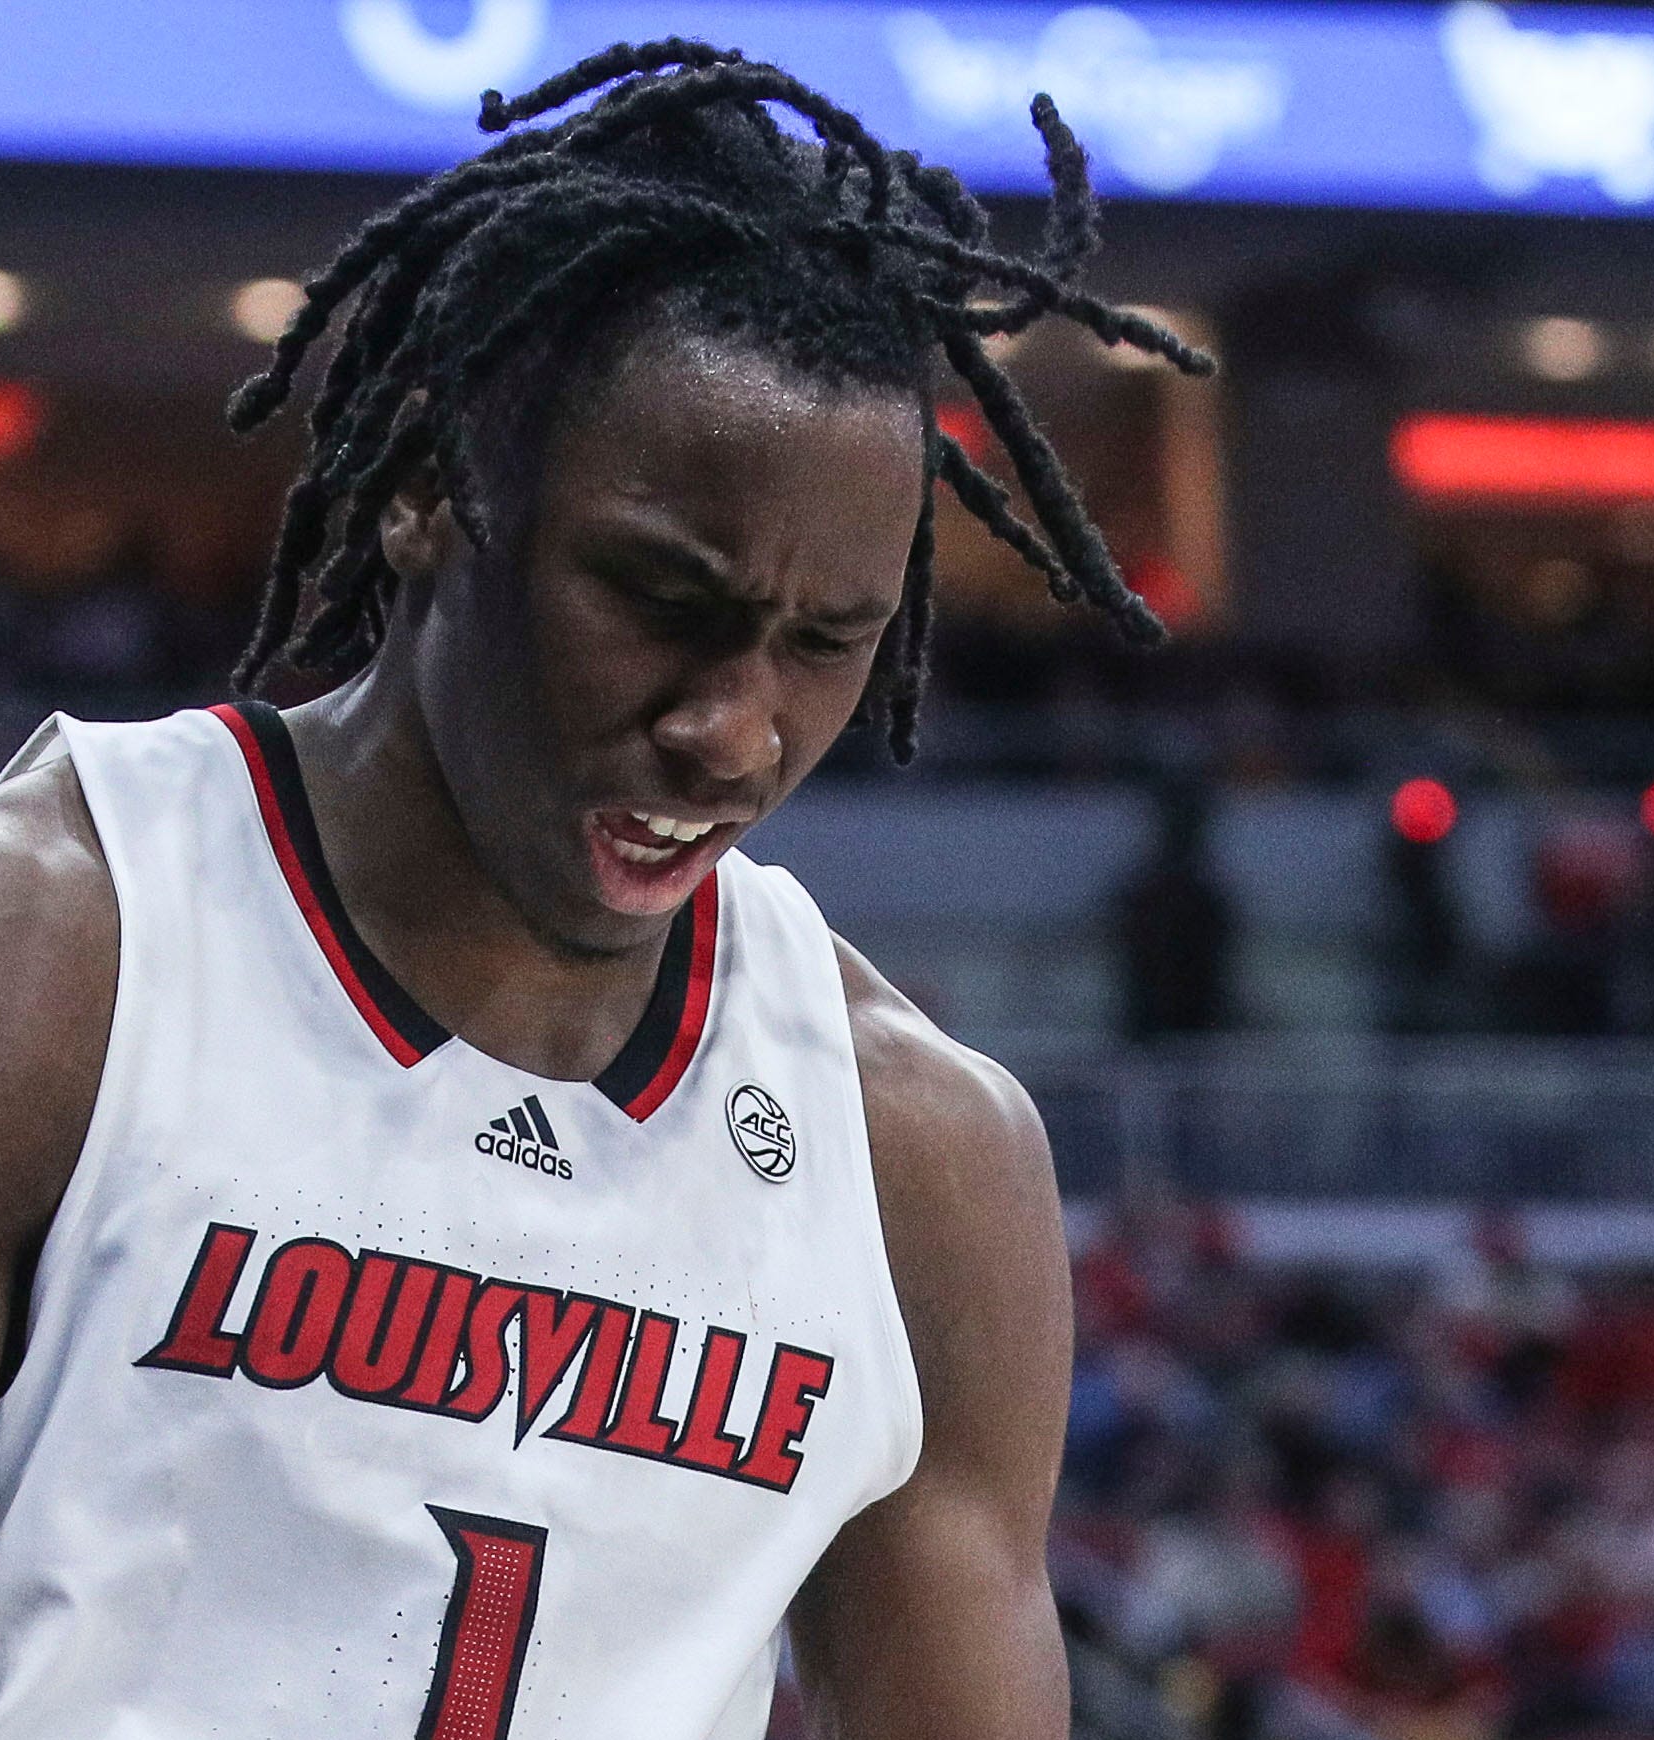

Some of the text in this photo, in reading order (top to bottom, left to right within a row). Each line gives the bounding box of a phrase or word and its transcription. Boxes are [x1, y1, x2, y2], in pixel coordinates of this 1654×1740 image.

[739, 1111, 792, 1146] ACC
[474, 1130, 573, 1181] adidas
[132, 1221, 835, 1495] LOUISVILLE
